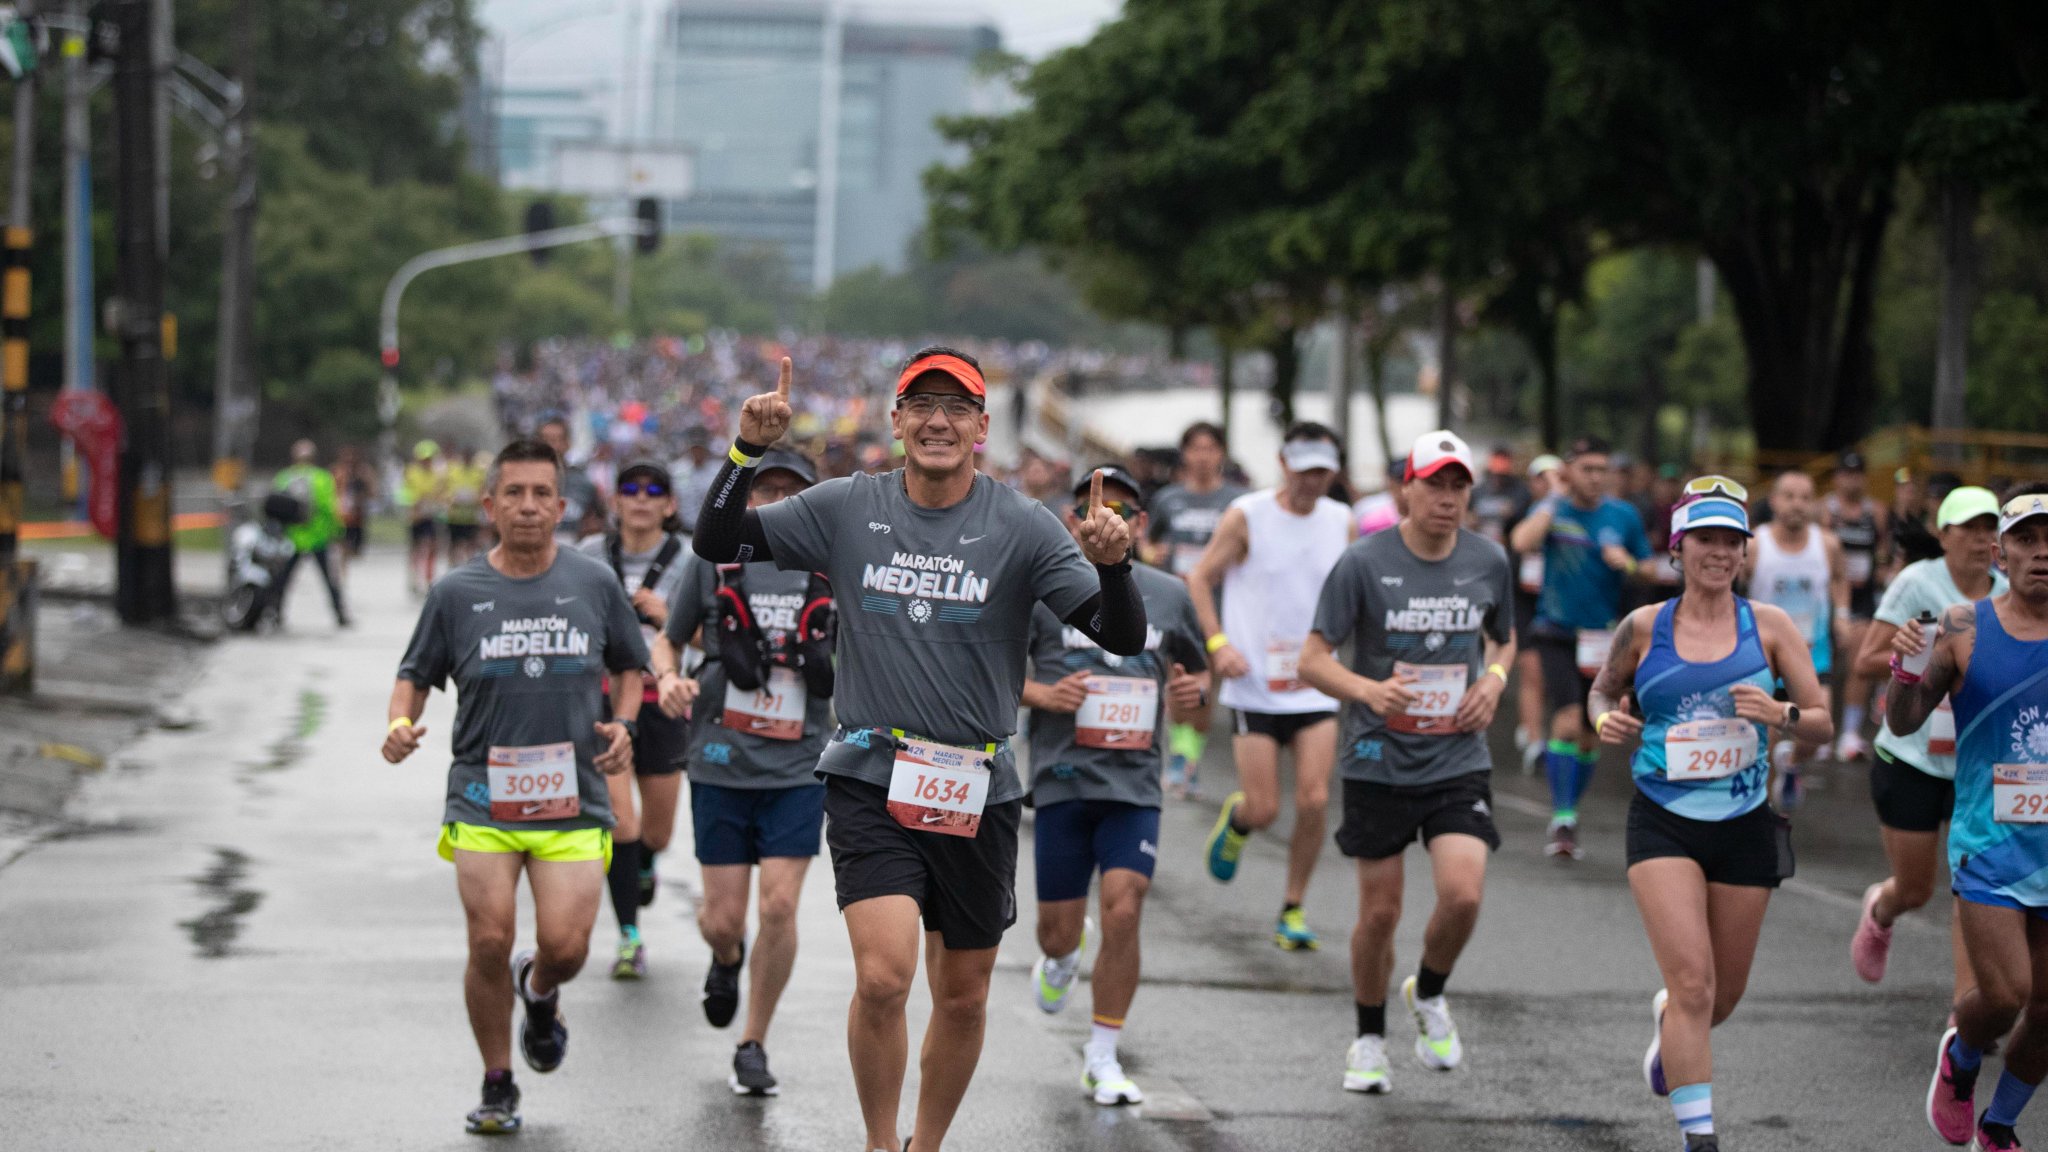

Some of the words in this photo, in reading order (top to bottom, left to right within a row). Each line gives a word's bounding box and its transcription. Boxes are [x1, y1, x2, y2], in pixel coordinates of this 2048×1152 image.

[868, 521, 891, 534] epm
[891, 552, 965, 574] MARATÓN
[861, 563, 989, 603] MEDELLÍN
[1408, 593, 1469, 611] MARATÓN
[501, 613, 568, 633] MARATÓN
[480, 626, 589, 660] MEDELLÍN
[1099, 703, 1141, 723] 1281
[2010, 705, 2041, 764] ARATÓN
[1687, 748, 1743, 772] 2941
[505, 771, 565, 796] 3099
[914, 775, 971, 805] 1634
